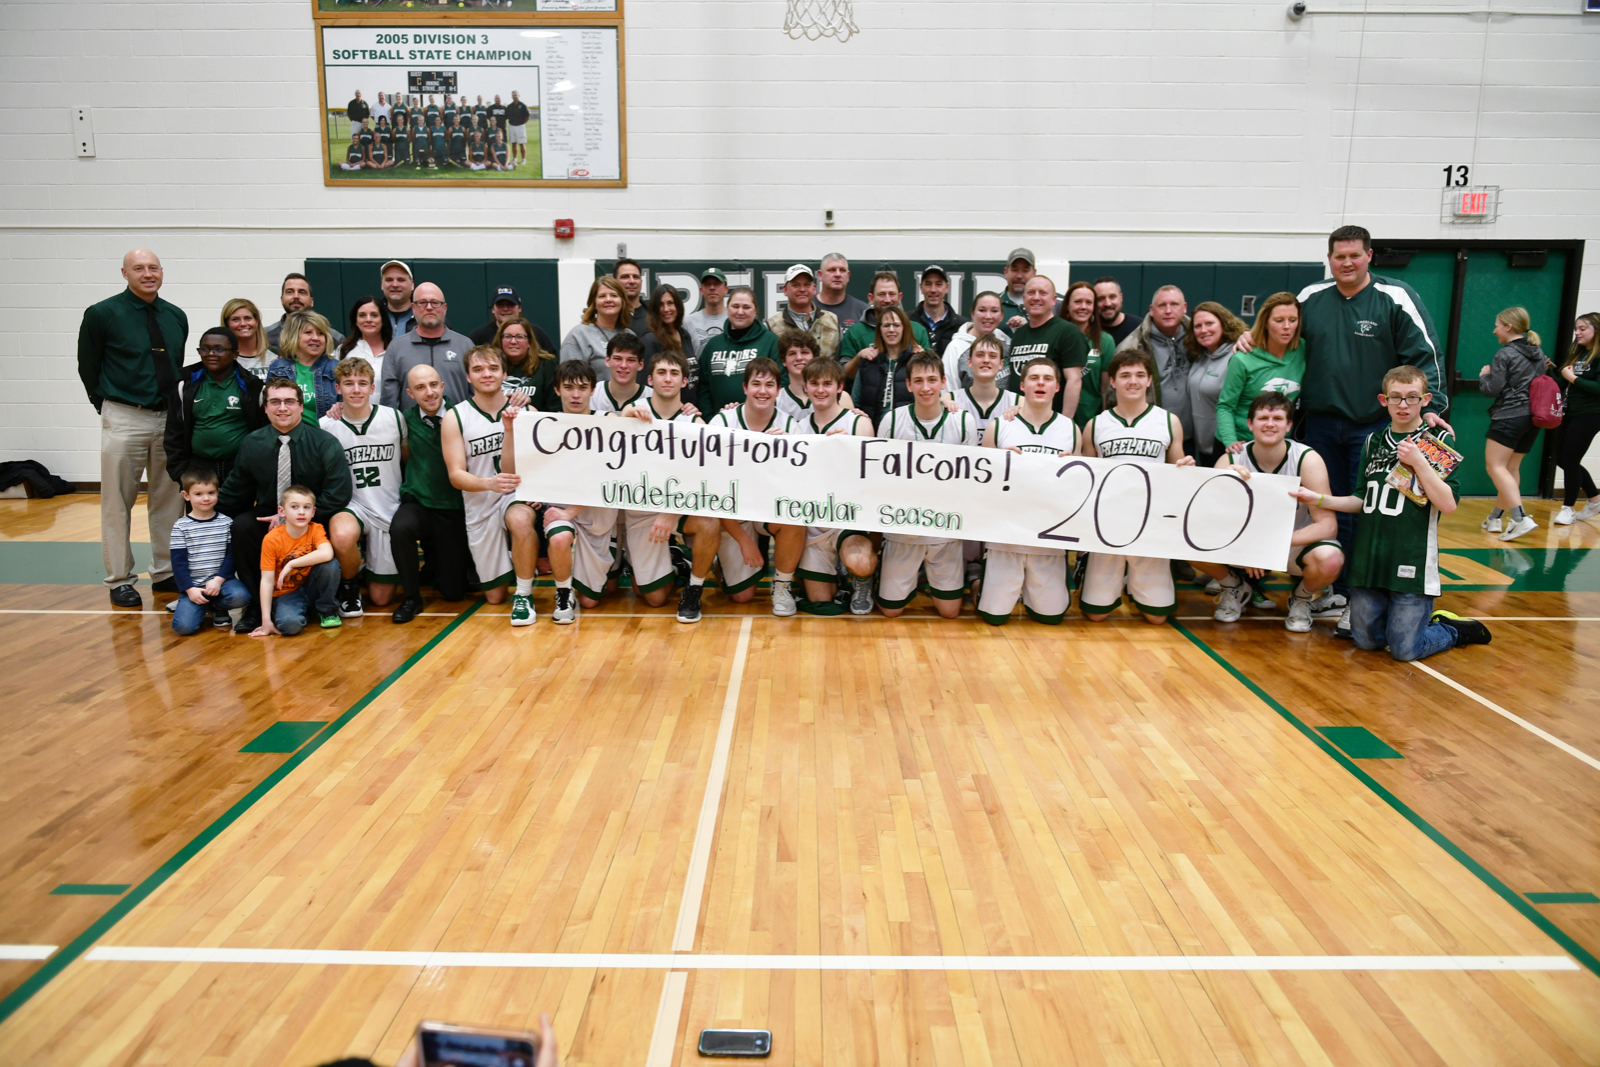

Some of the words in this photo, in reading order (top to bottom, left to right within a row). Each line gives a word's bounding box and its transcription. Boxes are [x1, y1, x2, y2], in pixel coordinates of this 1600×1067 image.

[375, 33, 409, 45] 2005
[413, 33, 476, 45] DIVISION
[481, 34, 489, 45] 3
[332, 49, 404, 60] SOFTBALL
[408, 49, 452, 60] STATE
[456, 50, 532, 61] CHAMPION
[1443, 165, 1469, 188] 13
[1461, 193, 1489, 214] EXIT
[711, 348, 758, 362] FALCONS
[1010, 343, 1049, 356] FREELAND
[345, 444, 395, 466] REELAND
[532, 416, 809, 470] Congratulations
[860, 439, 1011, 491] Falcons!
[1416, 439, 1454, 469] NARUTO
[352, 466, 382, 489] 32
[601, 471, 739, 515] undefeated
[775, 493, 862, 525] regular
[877, 504, 963, 530] season
[1037, 460, 1254, 551] 20-0
[1363, 480, 1406, 516] 00
